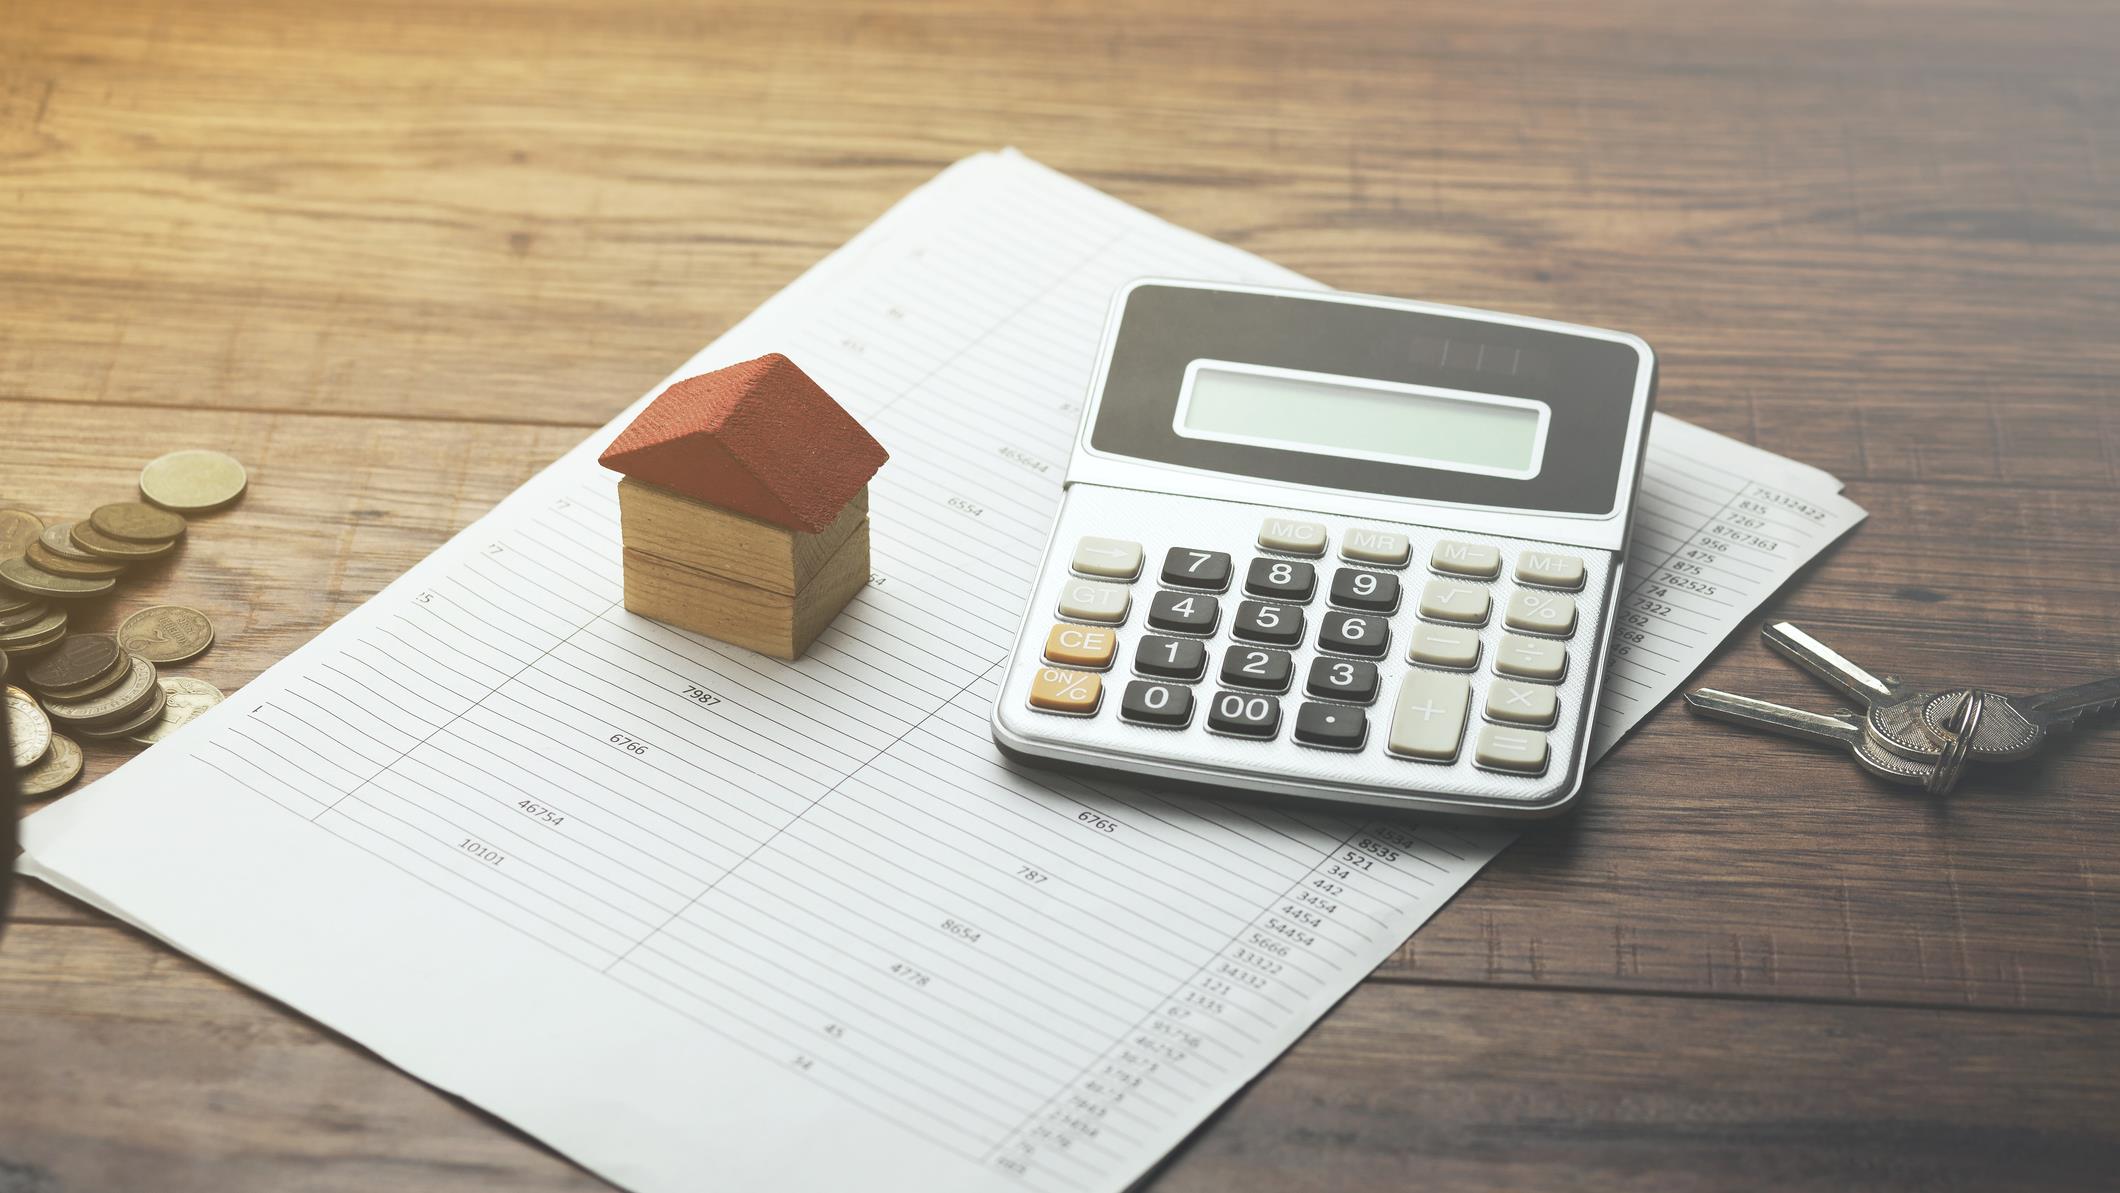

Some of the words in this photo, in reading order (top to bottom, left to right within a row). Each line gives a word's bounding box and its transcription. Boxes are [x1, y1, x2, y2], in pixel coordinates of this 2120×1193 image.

[947, 497, 984, 518] 6554
[1726, 513, 1766, 529] 7267
[1271, 522, 1315, 542] MC
[1355, 531, 1395, 551] MR
[1712, 525, 1779, 551] 8767363
[1700, 537, 1730, 552] 956
[1187, 553, 1212, 573] 7
[1687, 550, 1715, 564] 475
[1268, 564, 1292, 585] 8
[1672, 561, 1703, 576] 875
[1353, 574, 1377, 596] 9
[1646, 585, 1667, 597] 74
[1659, 573, 1717, 596] 762525
[1072, 586, 1120, 605] GT
[1171, 599, 1195, 619] 4
[1256, 607, 1281, 628] 5
[1633, 598, 1672, 617] 7322
[1341, 619, 1366, 640] 6
[1060, 631, 1105, 650] CE
[1164, 643, 1179, 662] 1
[1243, 653, 1267, 673] 2
[1329, 664, 1354, 686] 3
[681, 685, 721, 708] 7987
[1144, 687, 1169, 709] 0
[1221, 697, 1269, 720] 00
[609, 733, 649, 756] 6766
[517, 799, 564, 826] 46754
[1077, 811, 1118, 834] 6765
[458, 838, 505, 866] 10101
[1342, 851, 1375, 871] 521
[1358, 838, 1400, 863] 8535
[1015, 865, 1048, 885] 787
[1327, 865, 1350, 880] 34
[1313, 879, 1344, 897] 442
[1296, 891, 1337, 914] 3454
[1282, 905, 1322, 928] 4454
[940, 918, 981, 943] 8654
[1265, 918, 1315, 947] 54454
[1250, 932, 1290, 957] 5666
